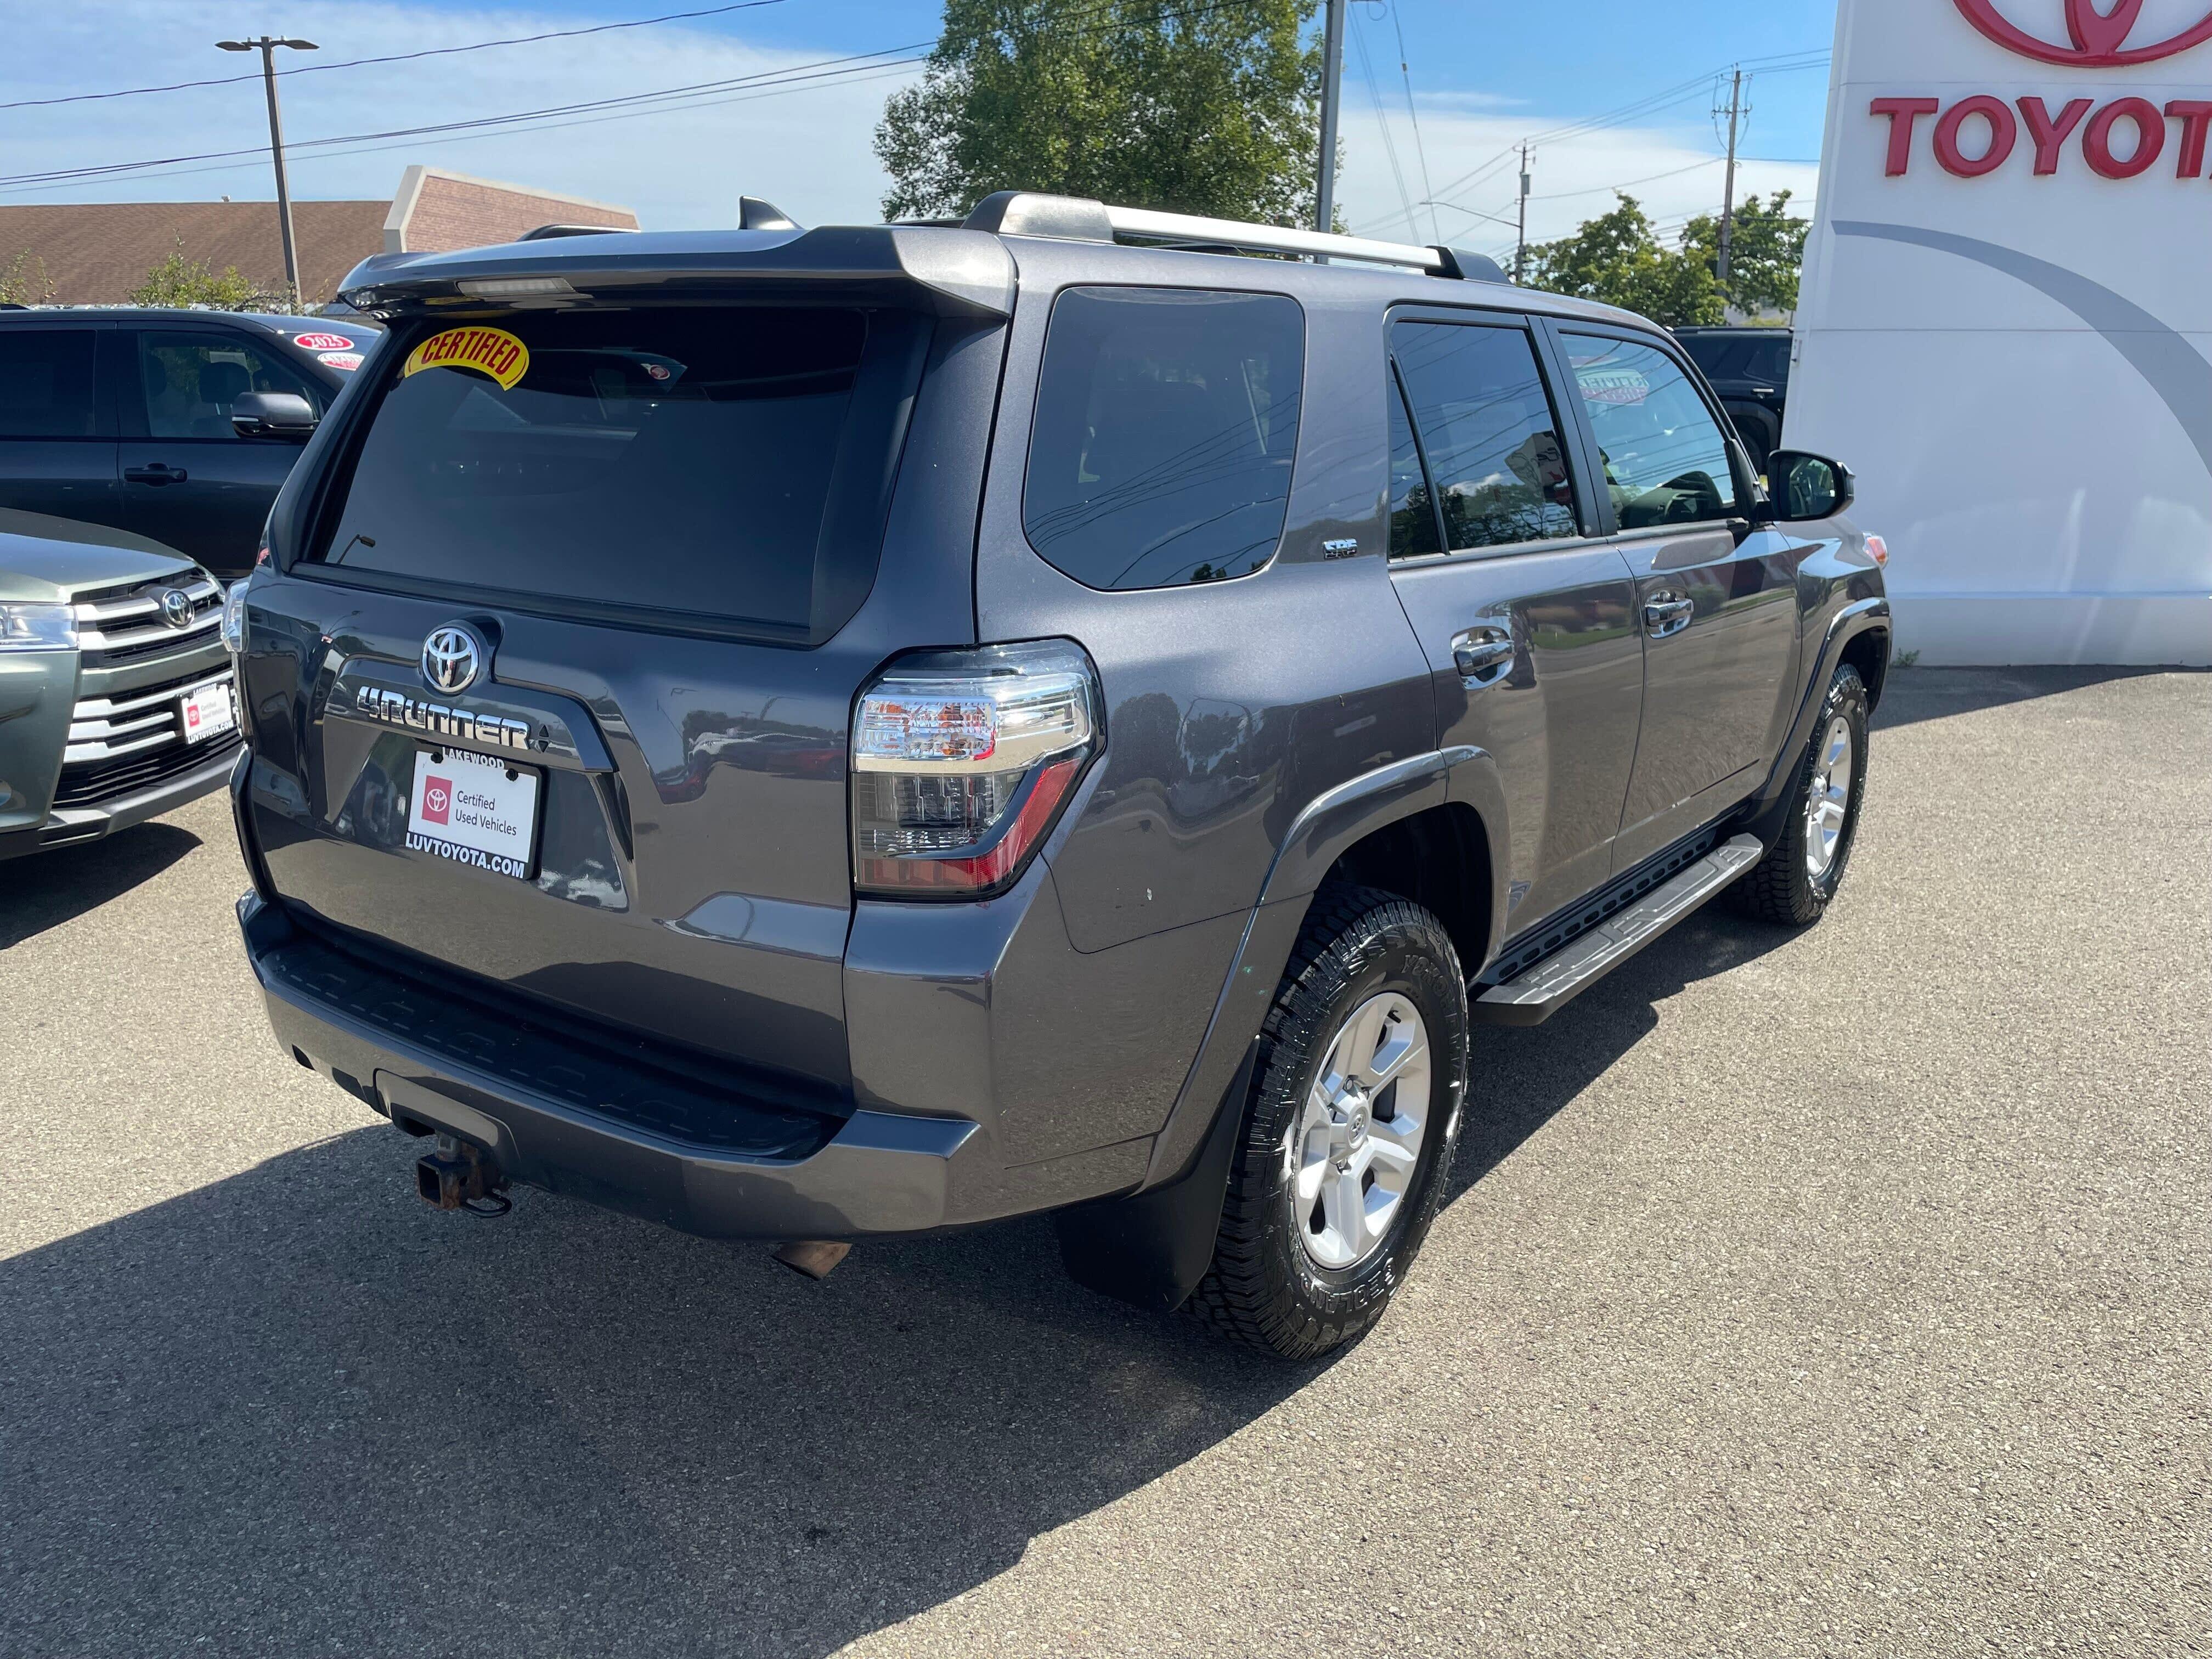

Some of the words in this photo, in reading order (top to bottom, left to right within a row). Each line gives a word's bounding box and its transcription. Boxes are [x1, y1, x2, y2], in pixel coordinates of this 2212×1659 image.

[1870, 95, 2212, 179] TOYOT
[304, 335, 343, 348] 2025
[421, 331, 520, 375] CERTIFIED
[1322, 538, 1357, 559] SR5
[188, 719, 234, 744] LUVTOYOTA.COM
[442, 747, 505, 769] LAKEWOOD
[457, 791, 495, 811] Certified
[456, 809, 477, 826] Used
[480, 815, 517, 836] Vehicles
[405, 832, 525, 879] LUVTOYOTA.COM
